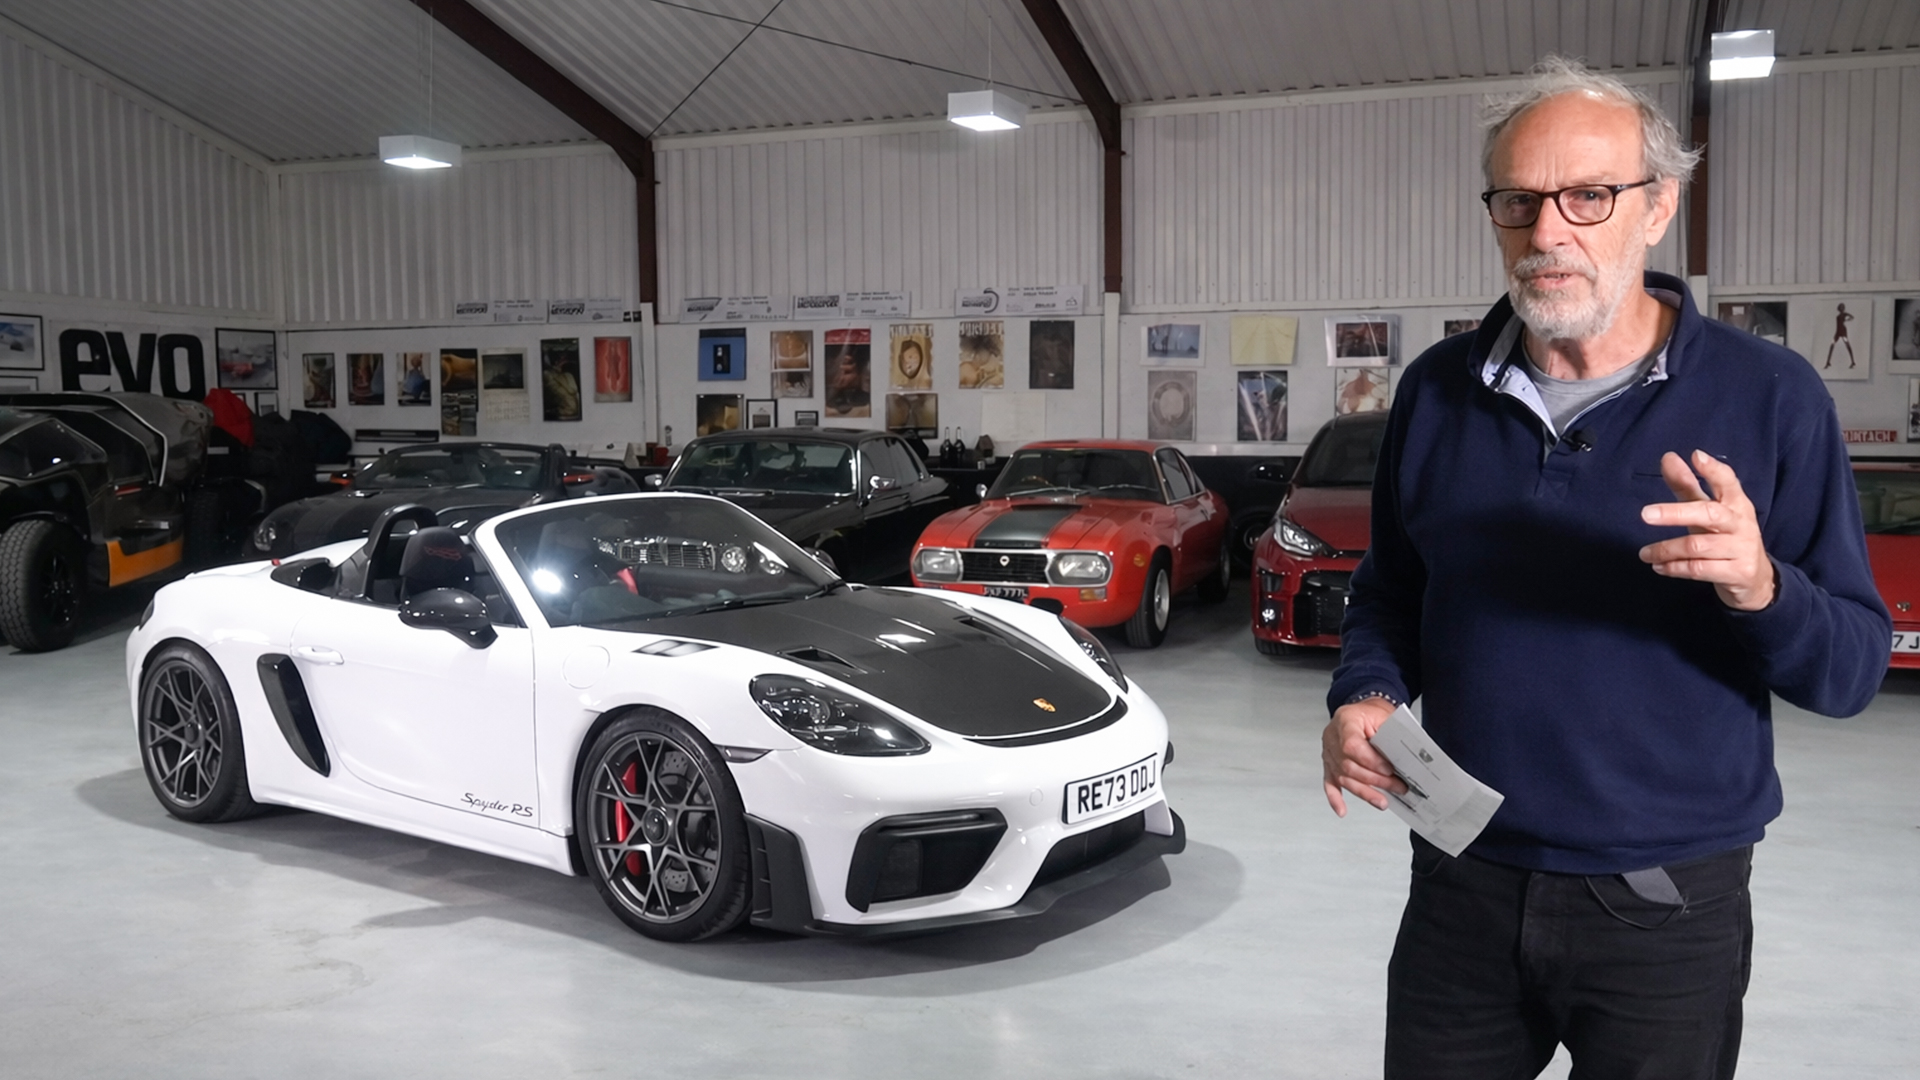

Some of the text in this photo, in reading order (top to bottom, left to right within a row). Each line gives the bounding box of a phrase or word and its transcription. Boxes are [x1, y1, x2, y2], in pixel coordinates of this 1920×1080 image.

[59, 329, 206, 401] evo
[460, 792, 534, 818] Spyder RS
[1077, 759, 1156, 815] RE73 DDJ
